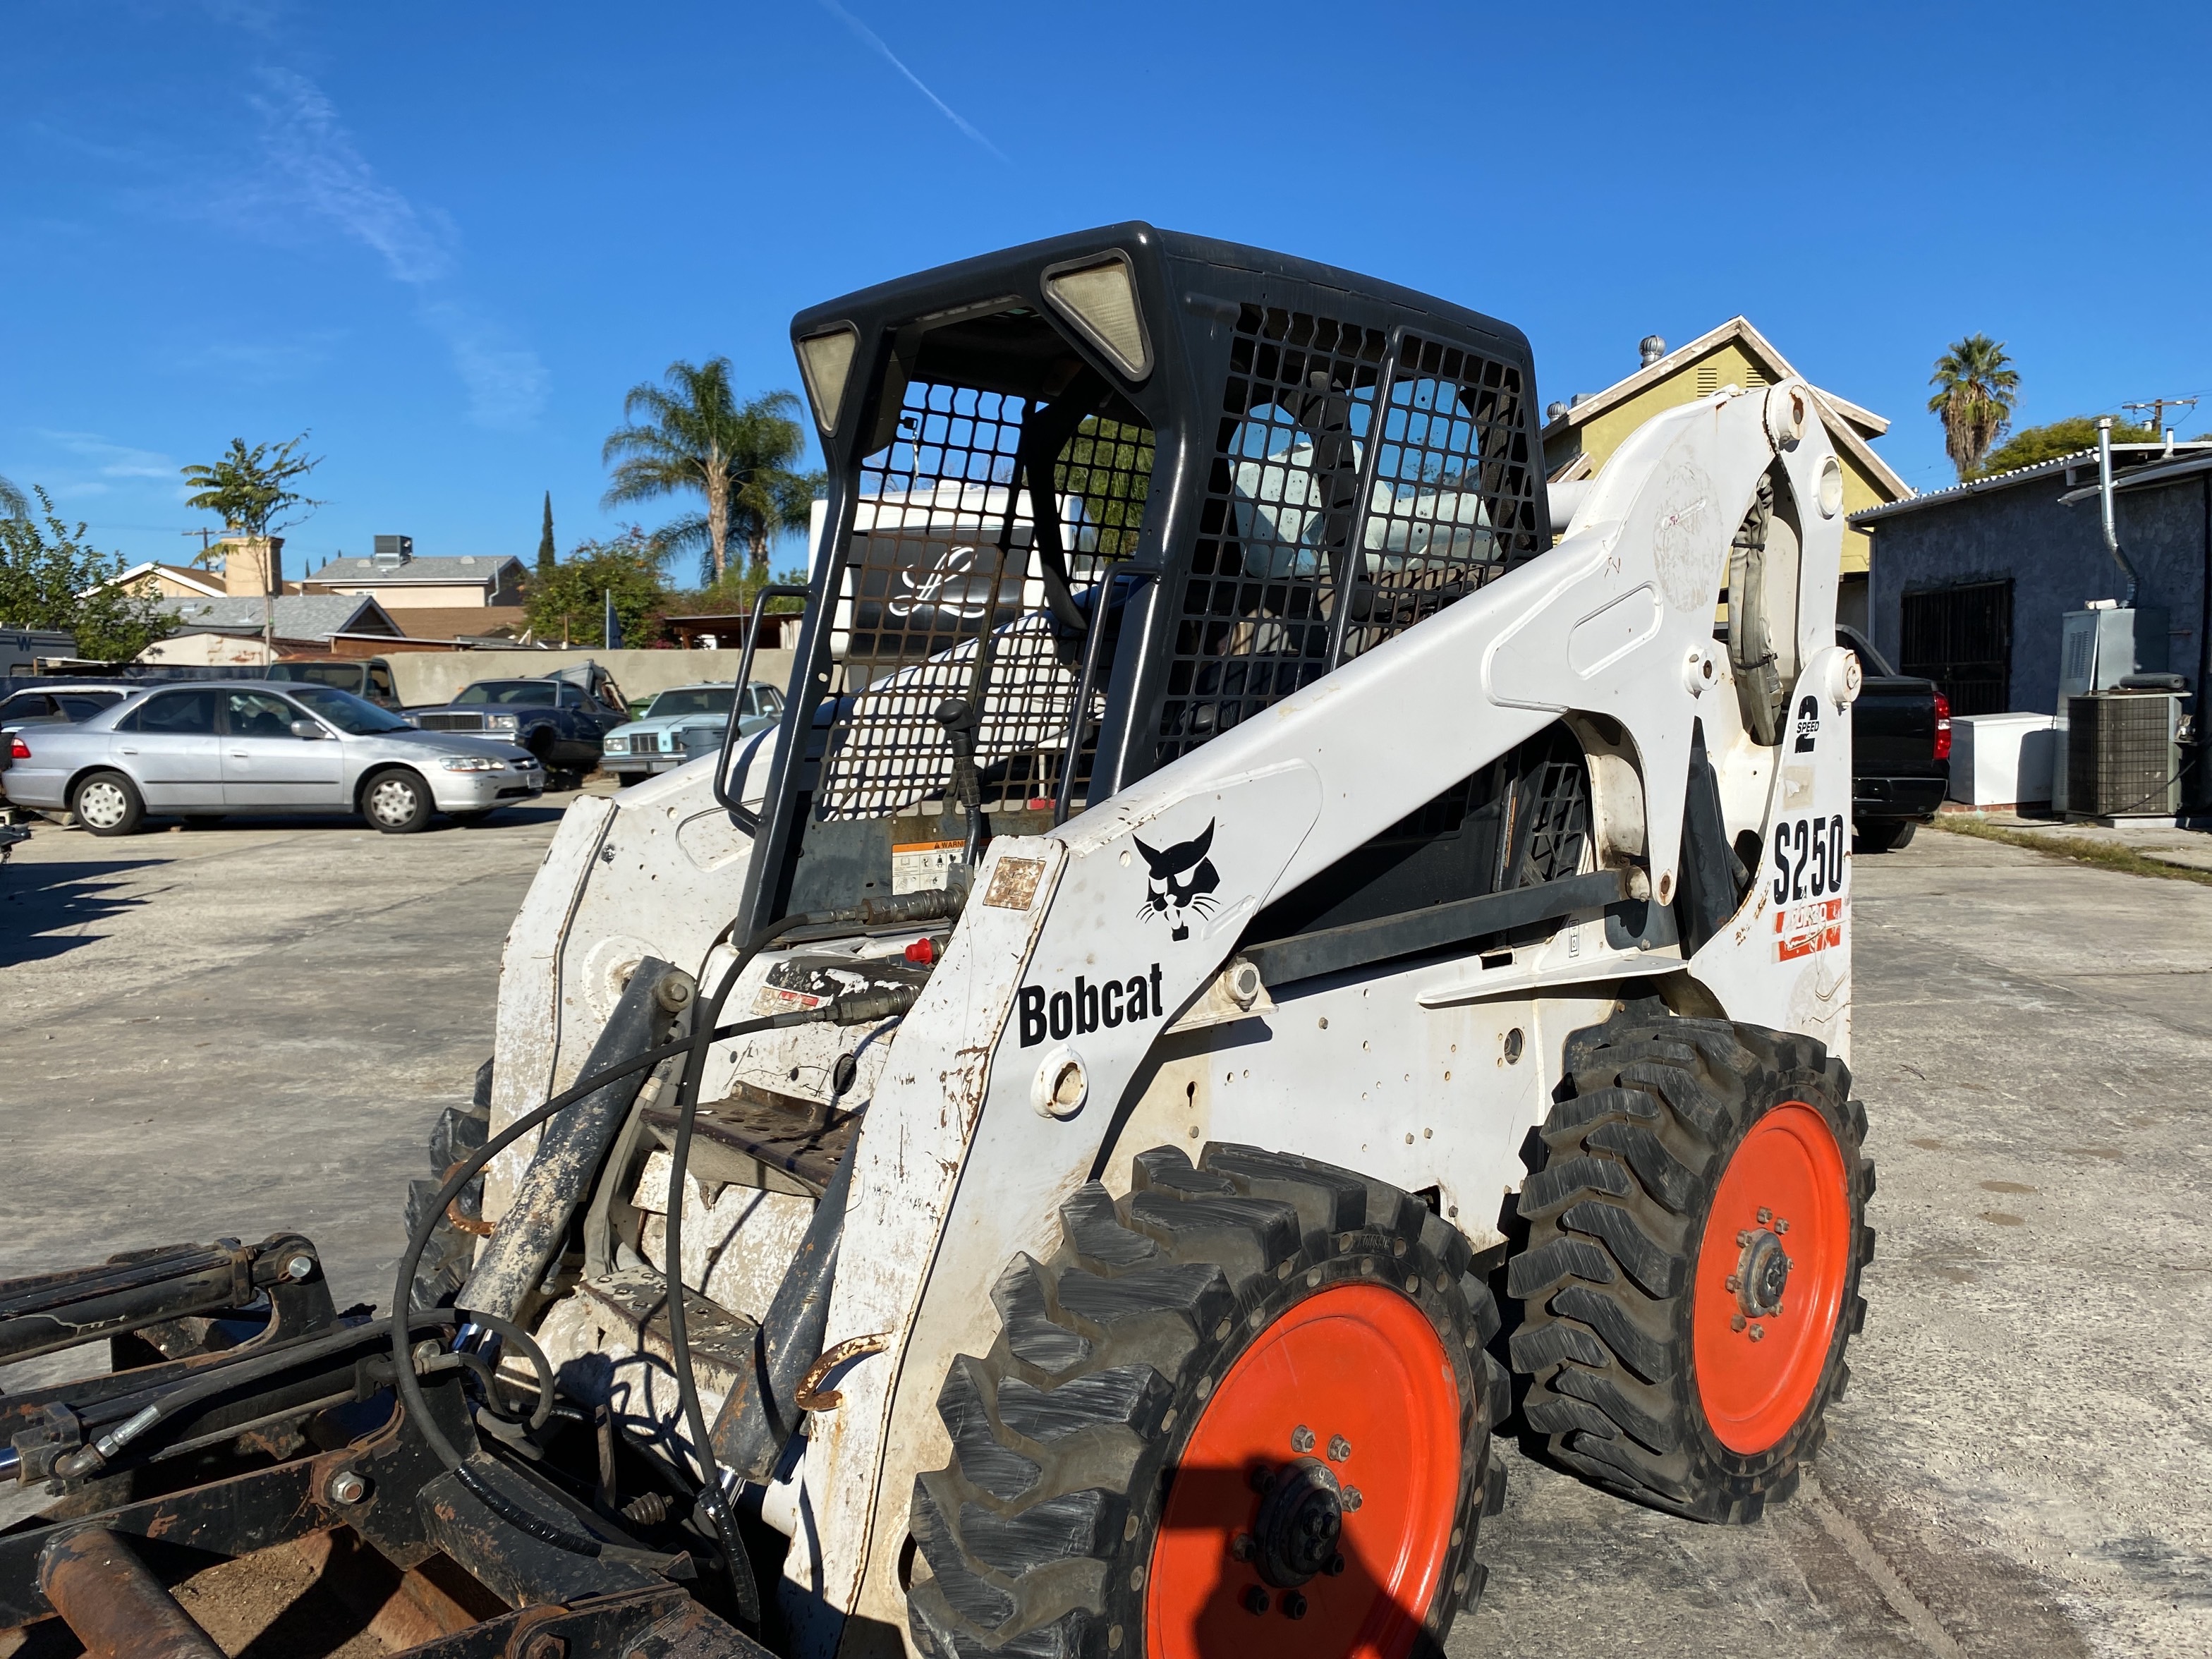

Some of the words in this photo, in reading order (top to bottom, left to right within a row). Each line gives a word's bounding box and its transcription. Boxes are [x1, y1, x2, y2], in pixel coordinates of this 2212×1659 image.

[16, 636, 32, 652] W
[1794, 695, 1818, 753] 2
[1797, 721, 1820, 734] SPEED
[941, 840, 965, 849] WARNI
[1773, 813, 1844, 905] S250
[1019, 963, 1162, 1048] Bobcat
